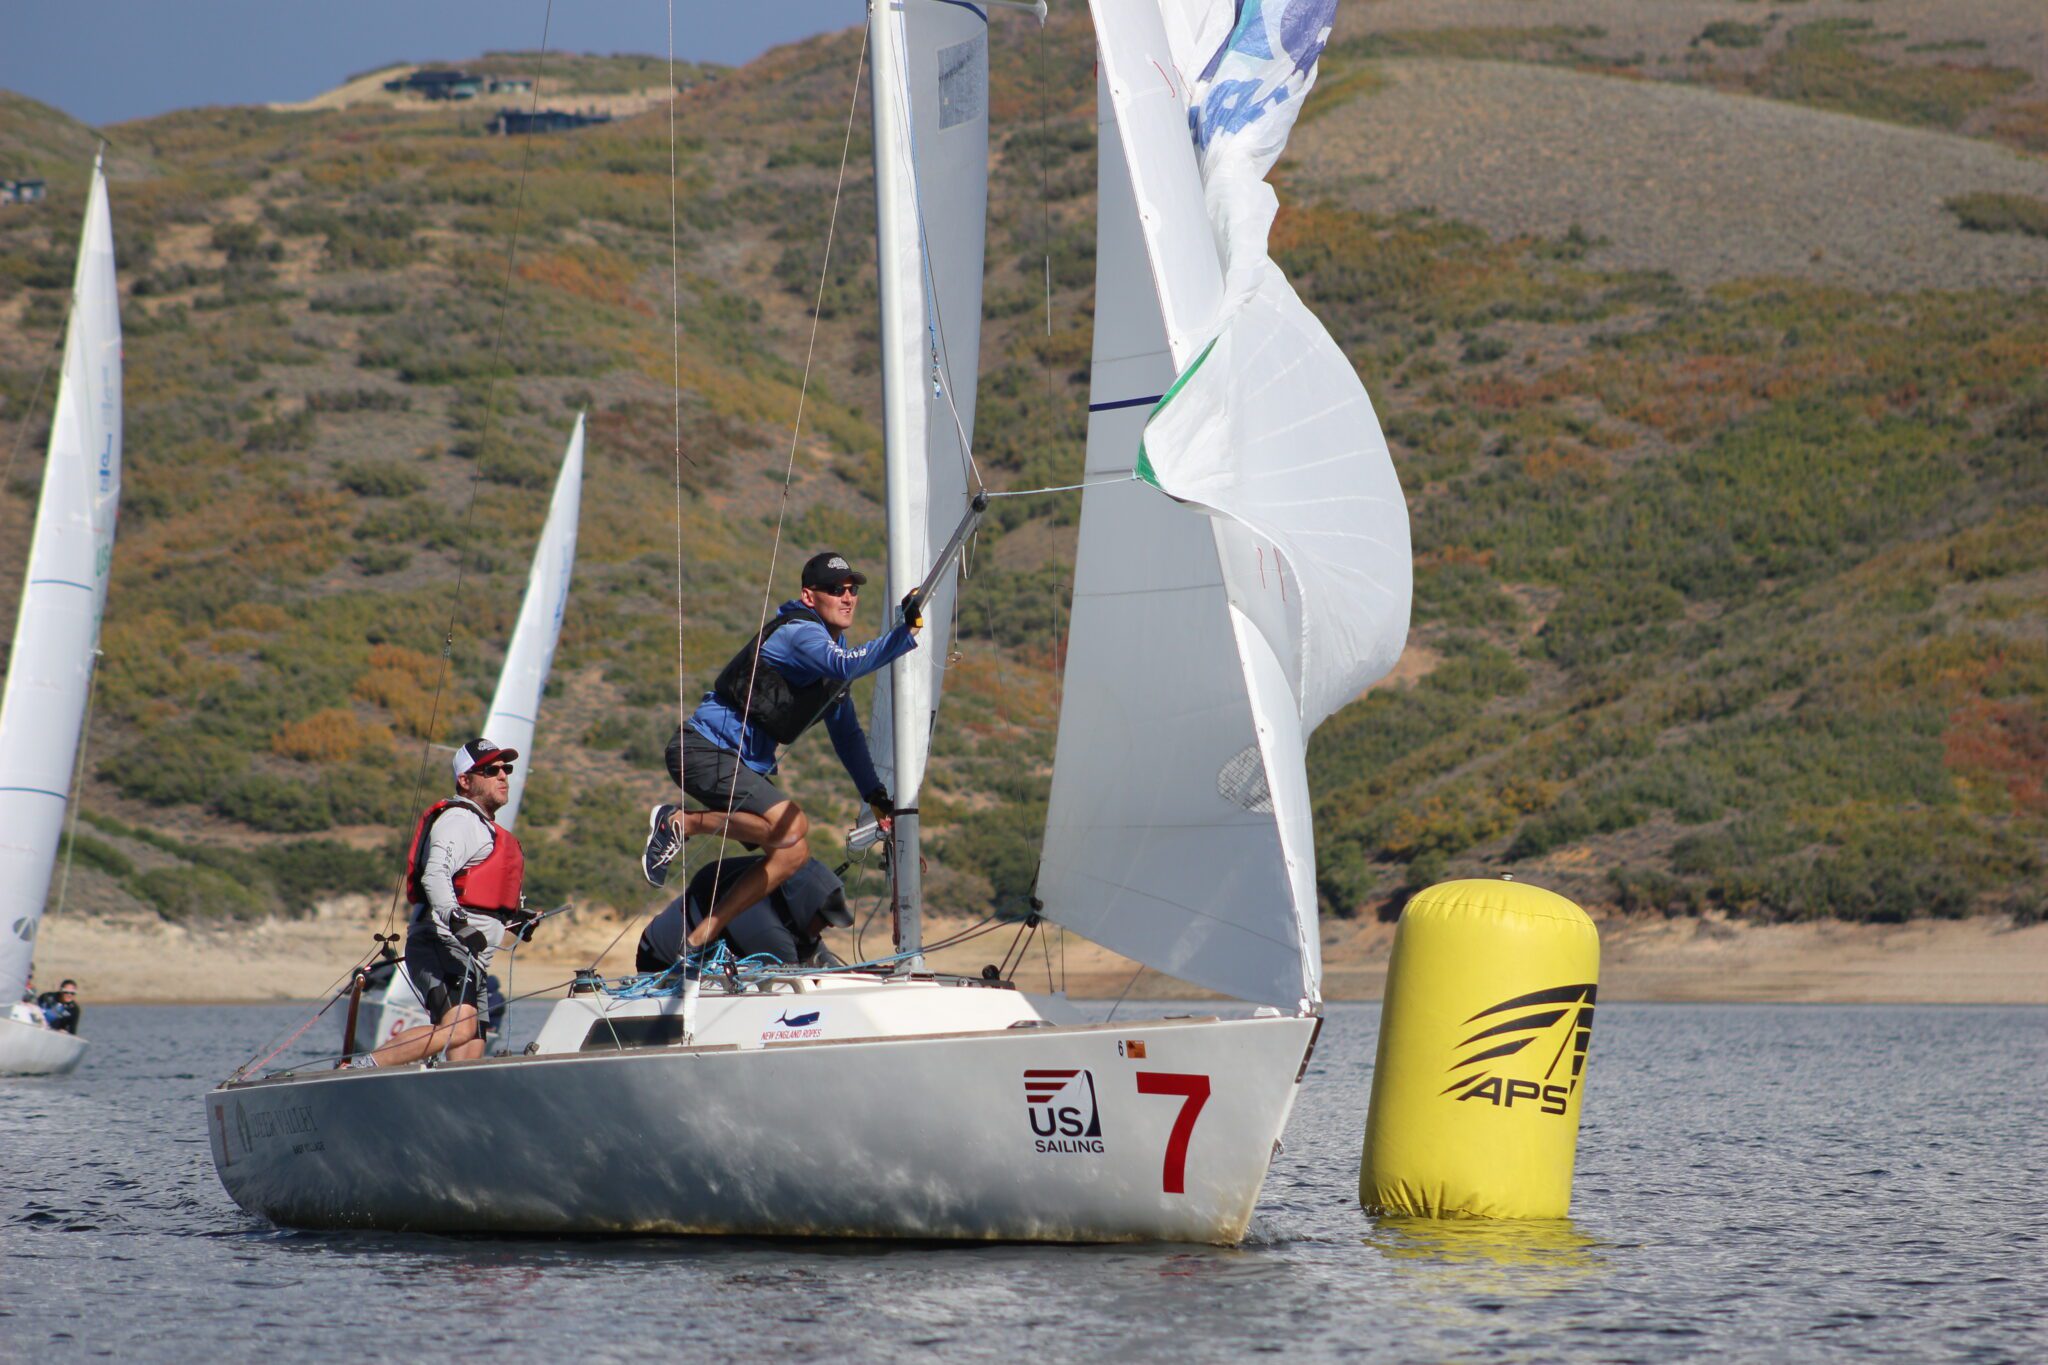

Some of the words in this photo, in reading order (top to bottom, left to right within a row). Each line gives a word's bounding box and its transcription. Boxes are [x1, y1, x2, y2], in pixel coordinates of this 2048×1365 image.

[761, 1031, 774, 1041] NEW
[775, 1030, 801, 1040] ENGLAND
[802, 1029, 822, 1039] ROPES
[1117, 1038, 1124, 1057] 6
[1455, 1076, 1568, 1116] APS
[1136, 1071, 1211, 1193] 7
[1035, 1140, 1104, 1153] SAILING
